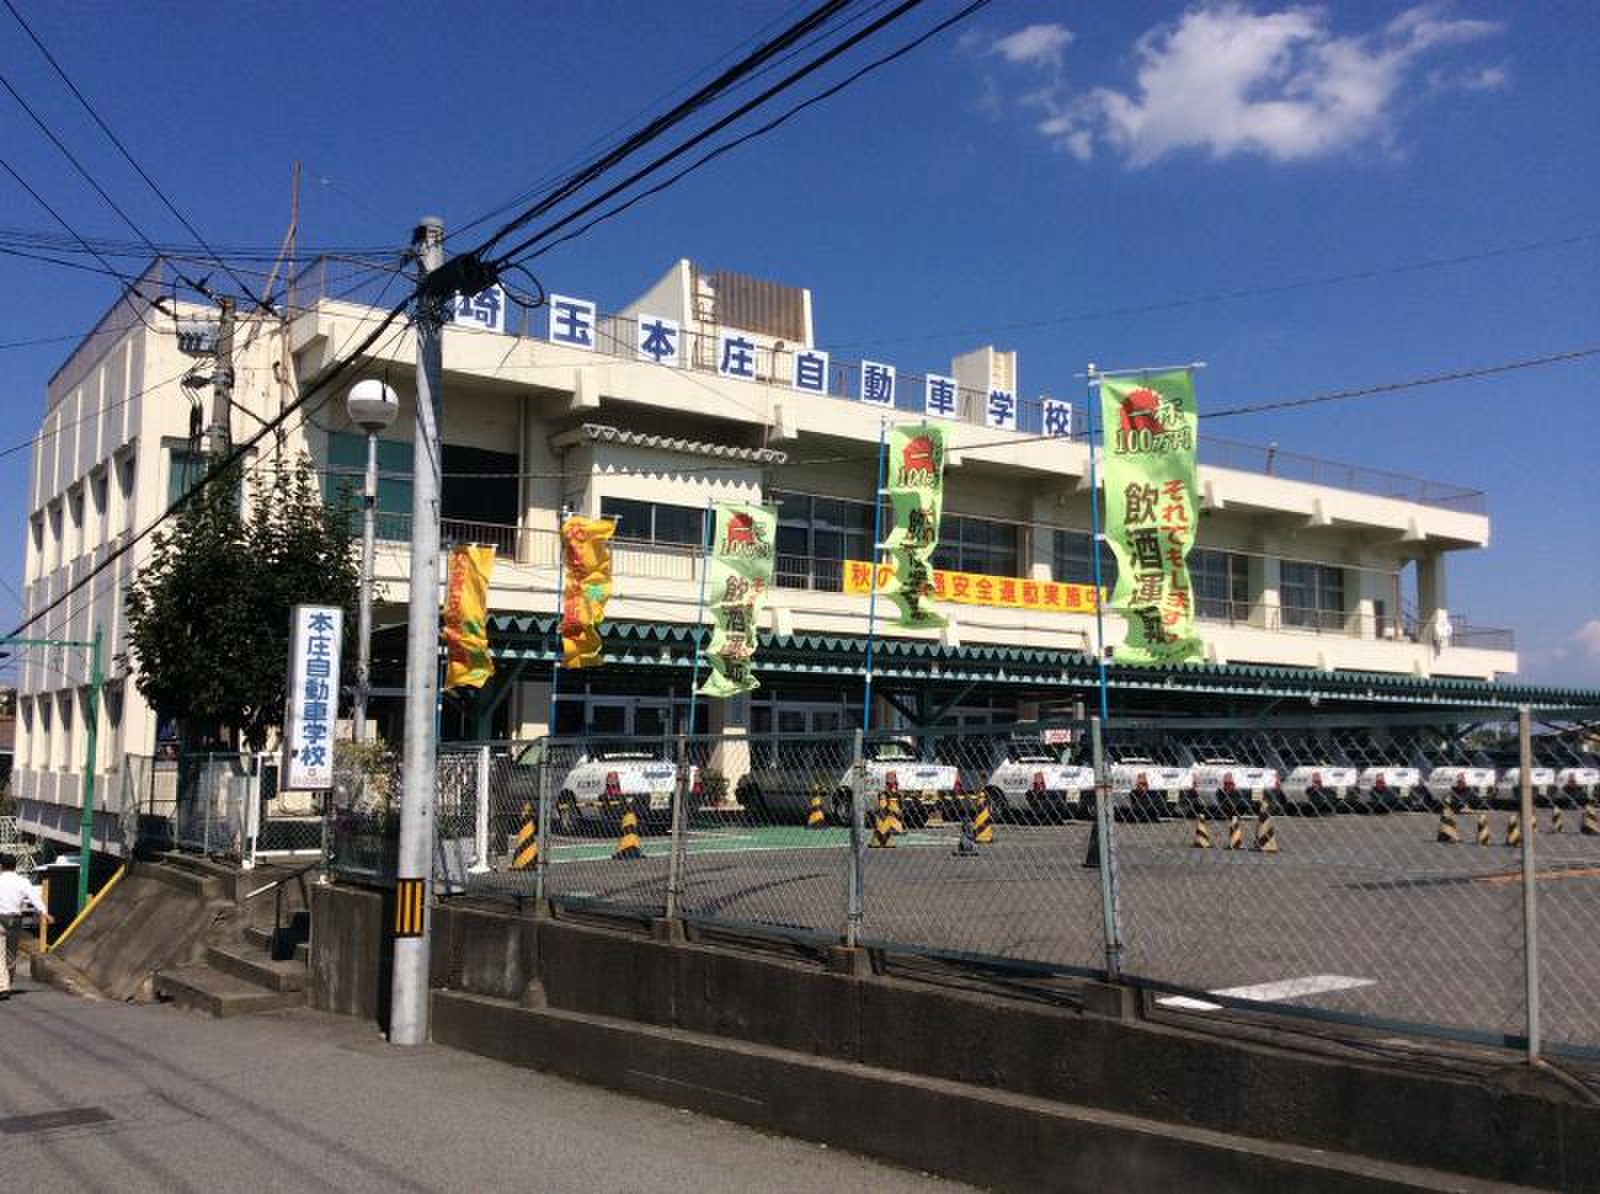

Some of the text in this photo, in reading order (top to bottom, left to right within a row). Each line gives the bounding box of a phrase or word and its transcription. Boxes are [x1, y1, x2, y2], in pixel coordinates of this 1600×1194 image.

[301, 611, 334, 767] 本庄自動車学校
